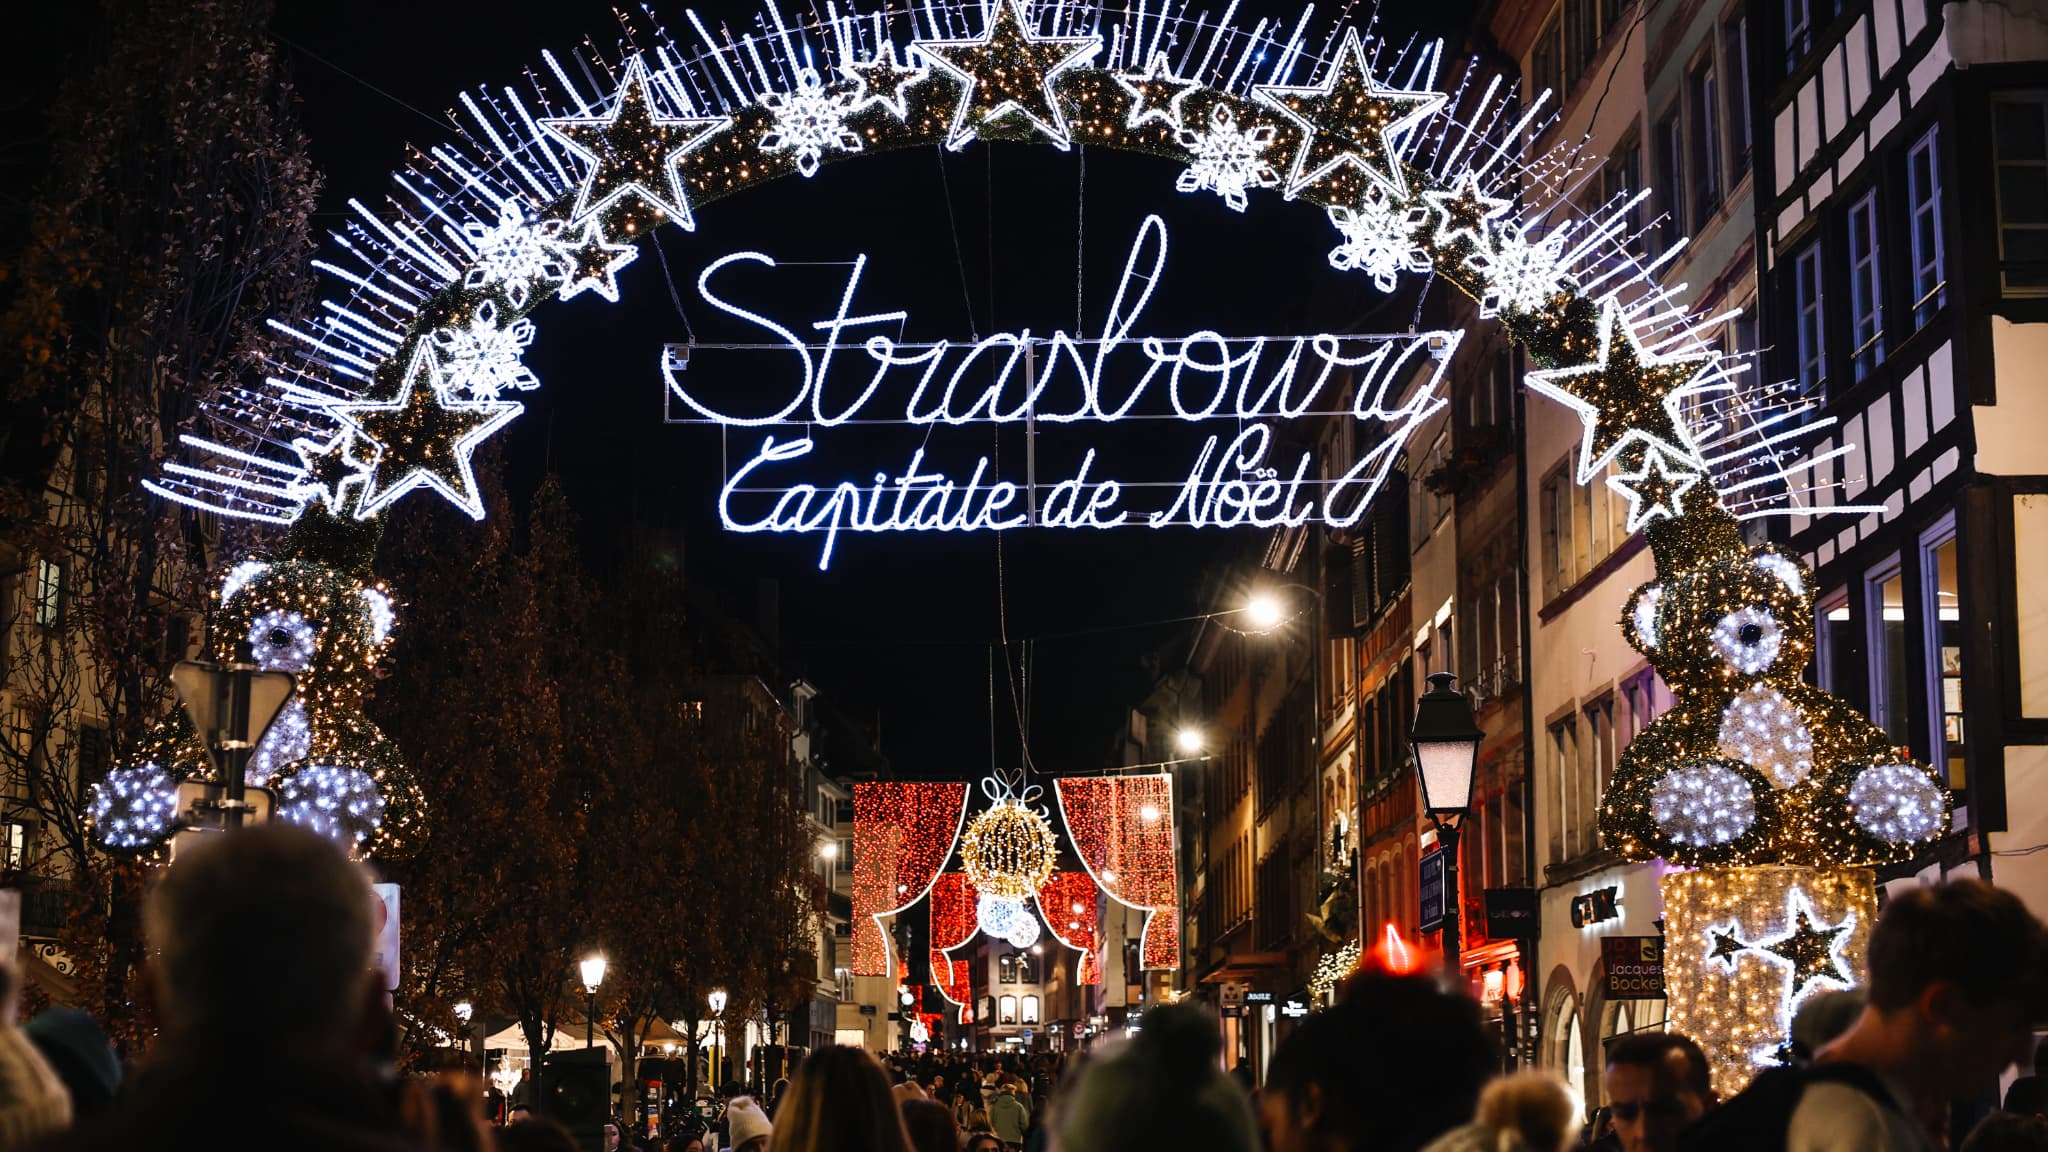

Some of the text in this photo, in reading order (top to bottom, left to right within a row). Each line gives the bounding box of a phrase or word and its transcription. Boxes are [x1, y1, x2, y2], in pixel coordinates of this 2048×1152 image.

[661, 214, 1465, 528] Strasbourg
[719, 422, 1314, 571] Capitale de Noël
[1609, 963, 1662, 977] Jacques
[1611, 975, 1662, 991] Bockel
